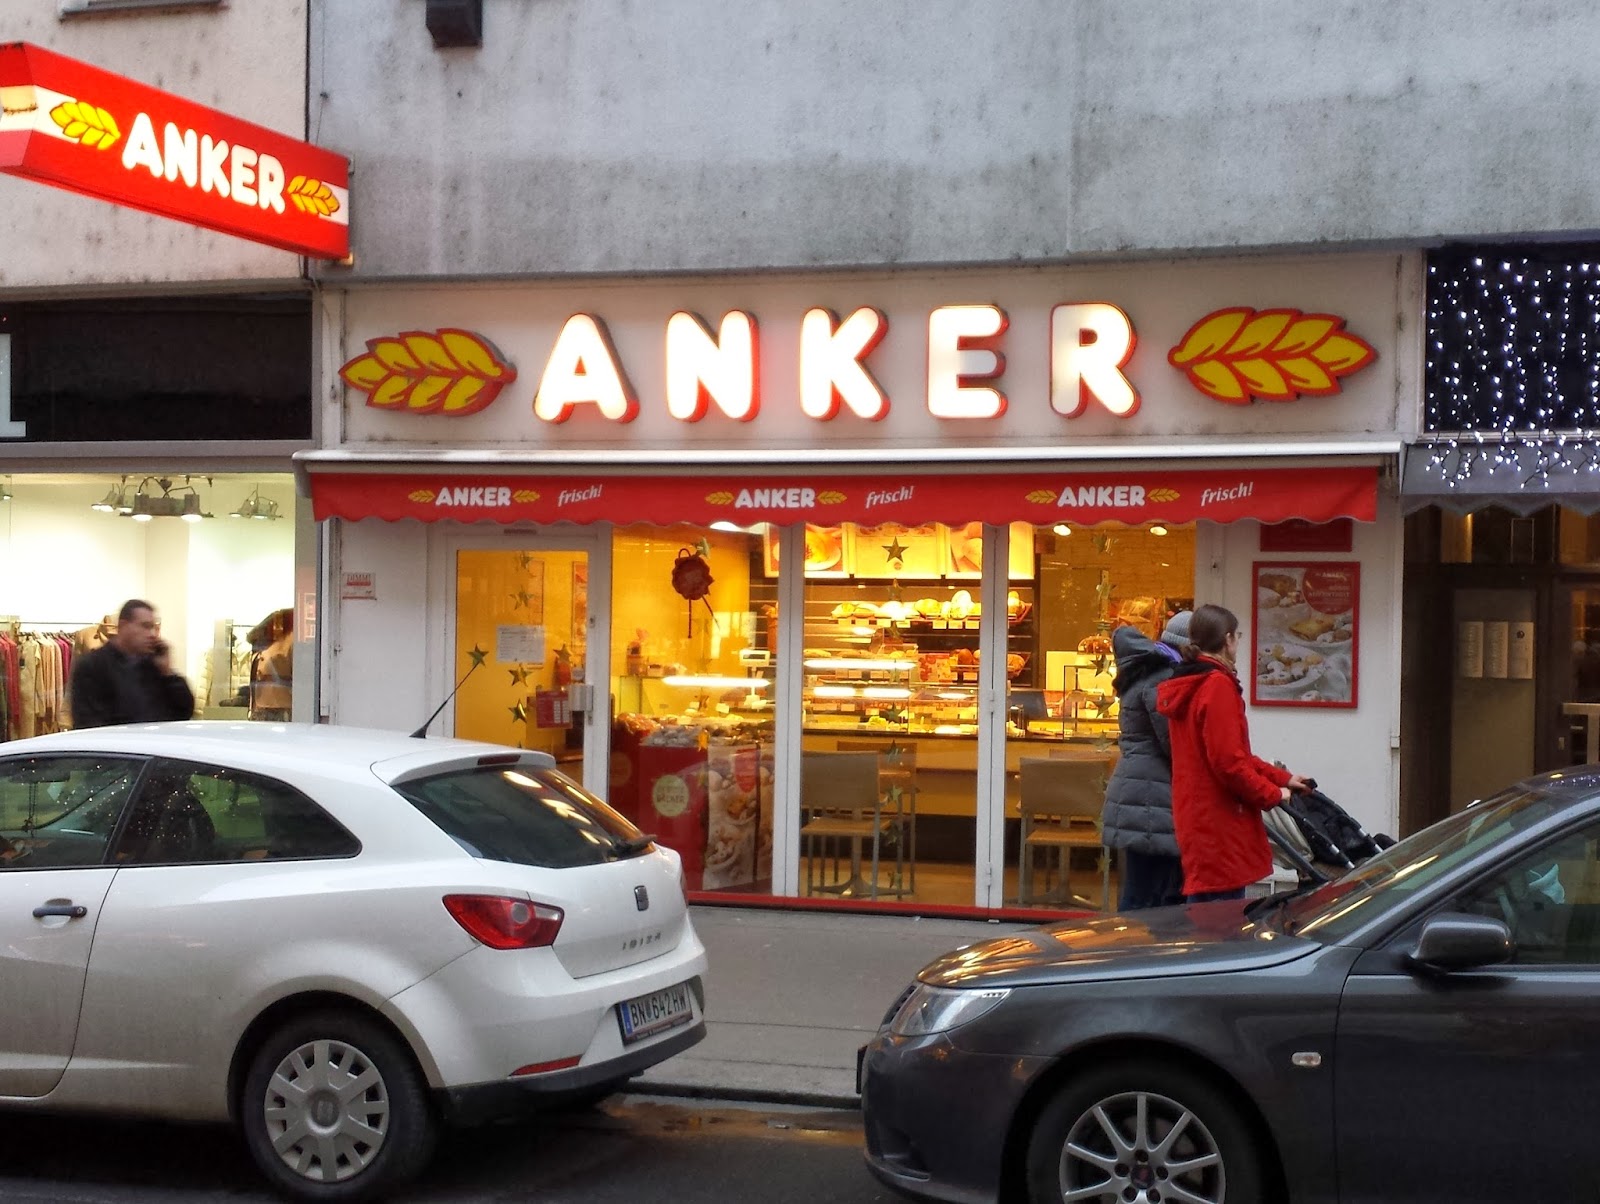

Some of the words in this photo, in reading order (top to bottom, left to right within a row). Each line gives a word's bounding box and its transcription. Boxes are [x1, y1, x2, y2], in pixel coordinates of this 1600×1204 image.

[121, 112, 286, 214] ANKER
[533, 302, 1138, 422] ANKER
[435, 487, 512, 507] ANKER
[558, 484, 603, 507] frisch!
[735, 488, 816, 508] ANKER
[865, 486, 914, 509] frisch!
[1057, 486, 1146, 507] ANKER
[1201, 482, 1254, 506] frisch!
[622, 932, 662, 950] IBIZA
[630, 1002, 647, 1028] BN
